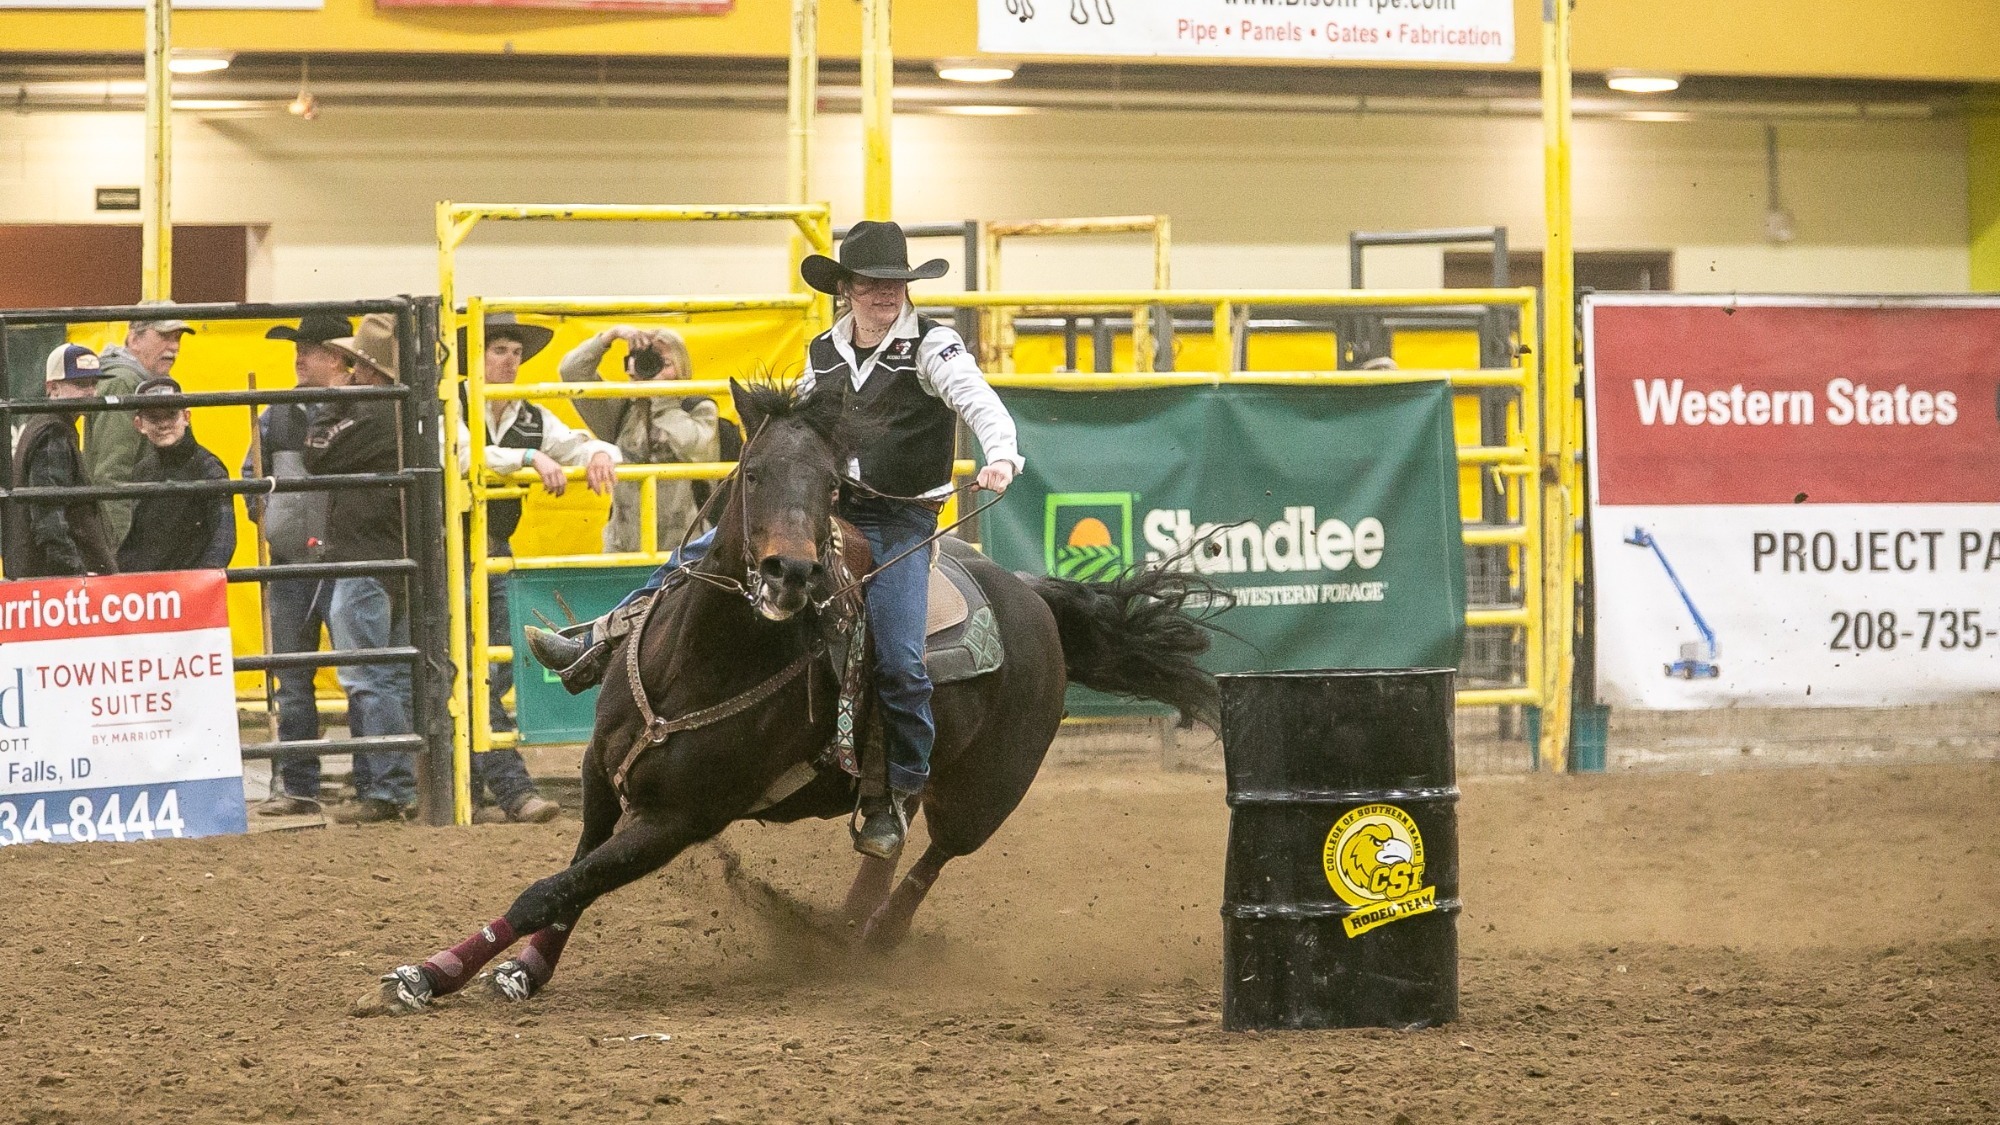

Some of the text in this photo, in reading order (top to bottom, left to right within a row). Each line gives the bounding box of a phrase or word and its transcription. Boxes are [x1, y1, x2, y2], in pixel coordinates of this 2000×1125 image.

[1178, 18, 1502, 46] Pipe Panels Gates Fabrication
[1633, 376, 1959, 426] Western States
[1143, 505, 1386, 574] Standlee
[1753, 530, 1944, 574] PROJECT
[0, 588, 182, 631] rriott.com
[1233, 584, 1320, 607] WESTERN
[36, 652, 223, 690] TOWNEPLACE
[91, 691, 173, 717] SUITES
[92, 728, 173, 746] BY MARRIOTT
[8, 757, 92, 784] Falls, ID
[0, 788, 185, 846] 34-8444
[1326, 805, 1422, 872] COLLEGE OF SOUTHERN IDAHO
[1369, 862, 1424, 899] CSI
[1350, 893, 1433, 930] RODEO TEAM
